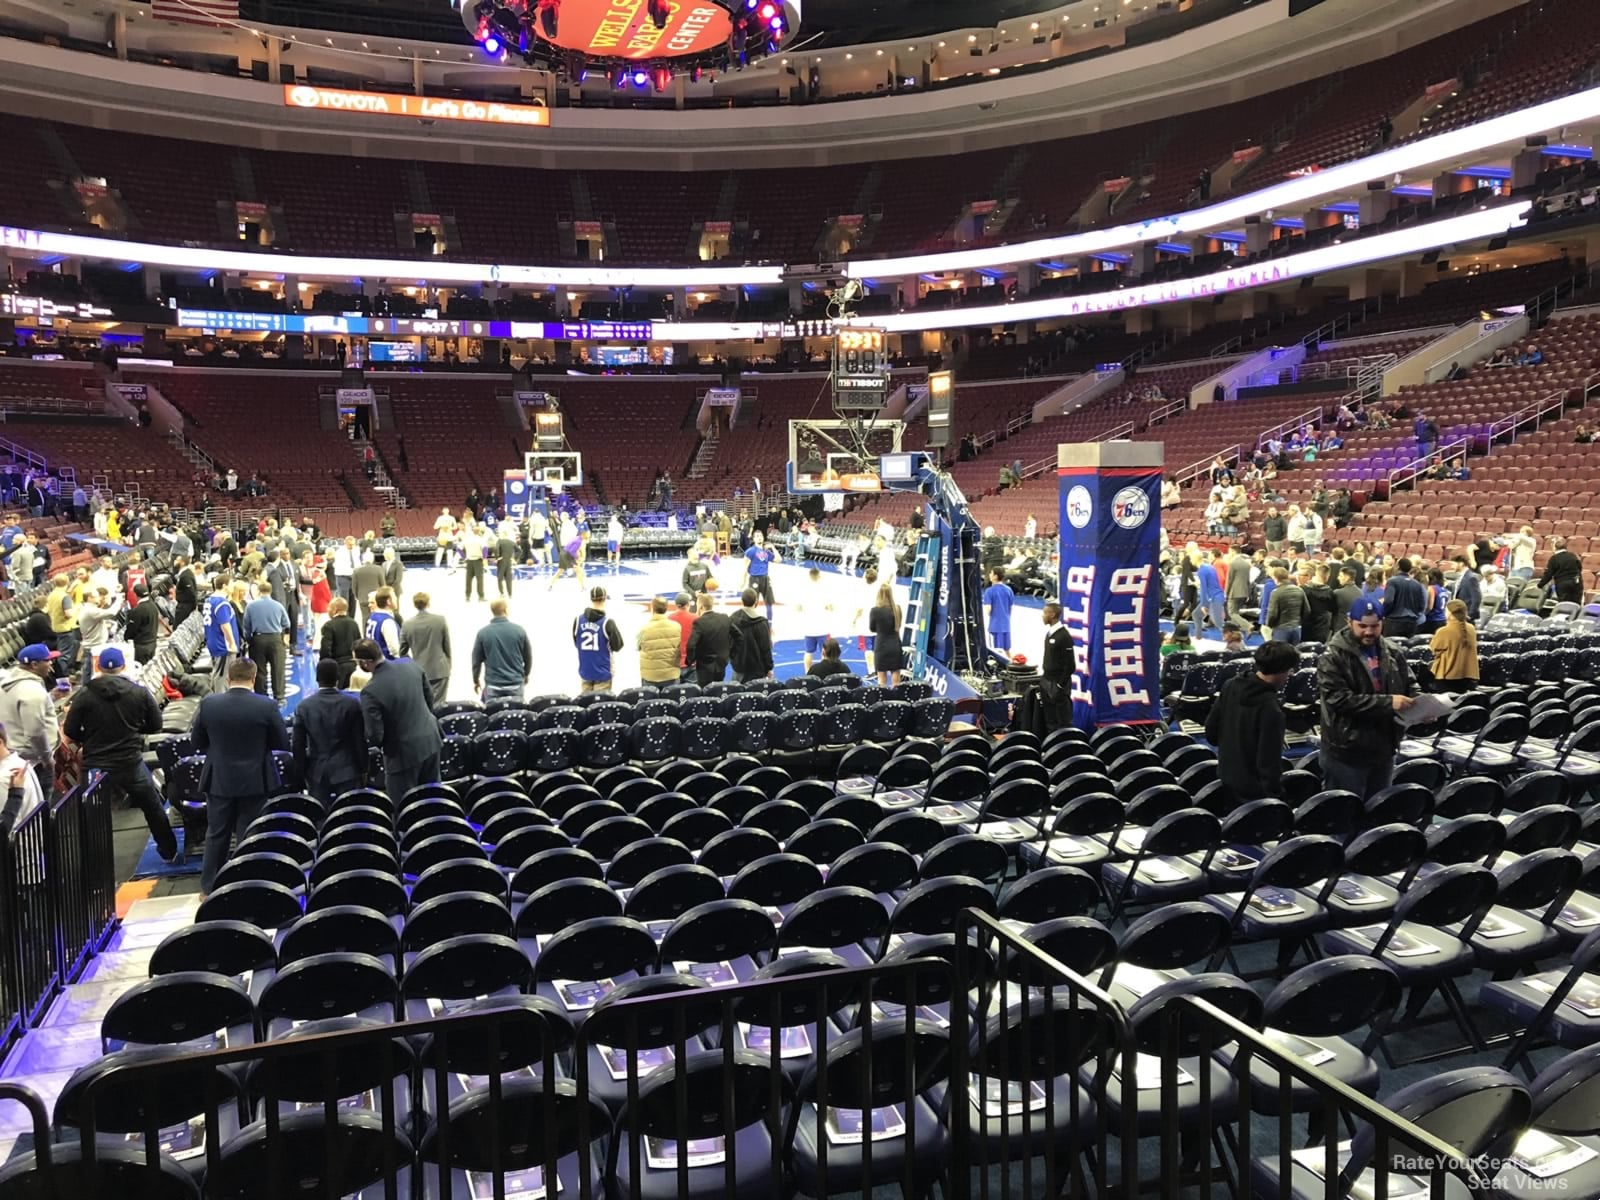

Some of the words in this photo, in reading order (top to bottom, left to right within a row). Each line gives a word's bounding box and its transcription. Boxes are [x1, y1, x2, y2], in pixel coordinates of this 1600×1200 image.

[667, 7, 718, 50] CENTER
[320, 91, 388, 113] TOYOTA
[421, 98, 458, 118] Let's
[463, 101, 485, 120] Go
[580, 631, 600, 651] 21
[1103, 563, 1153, 708] PHILA
